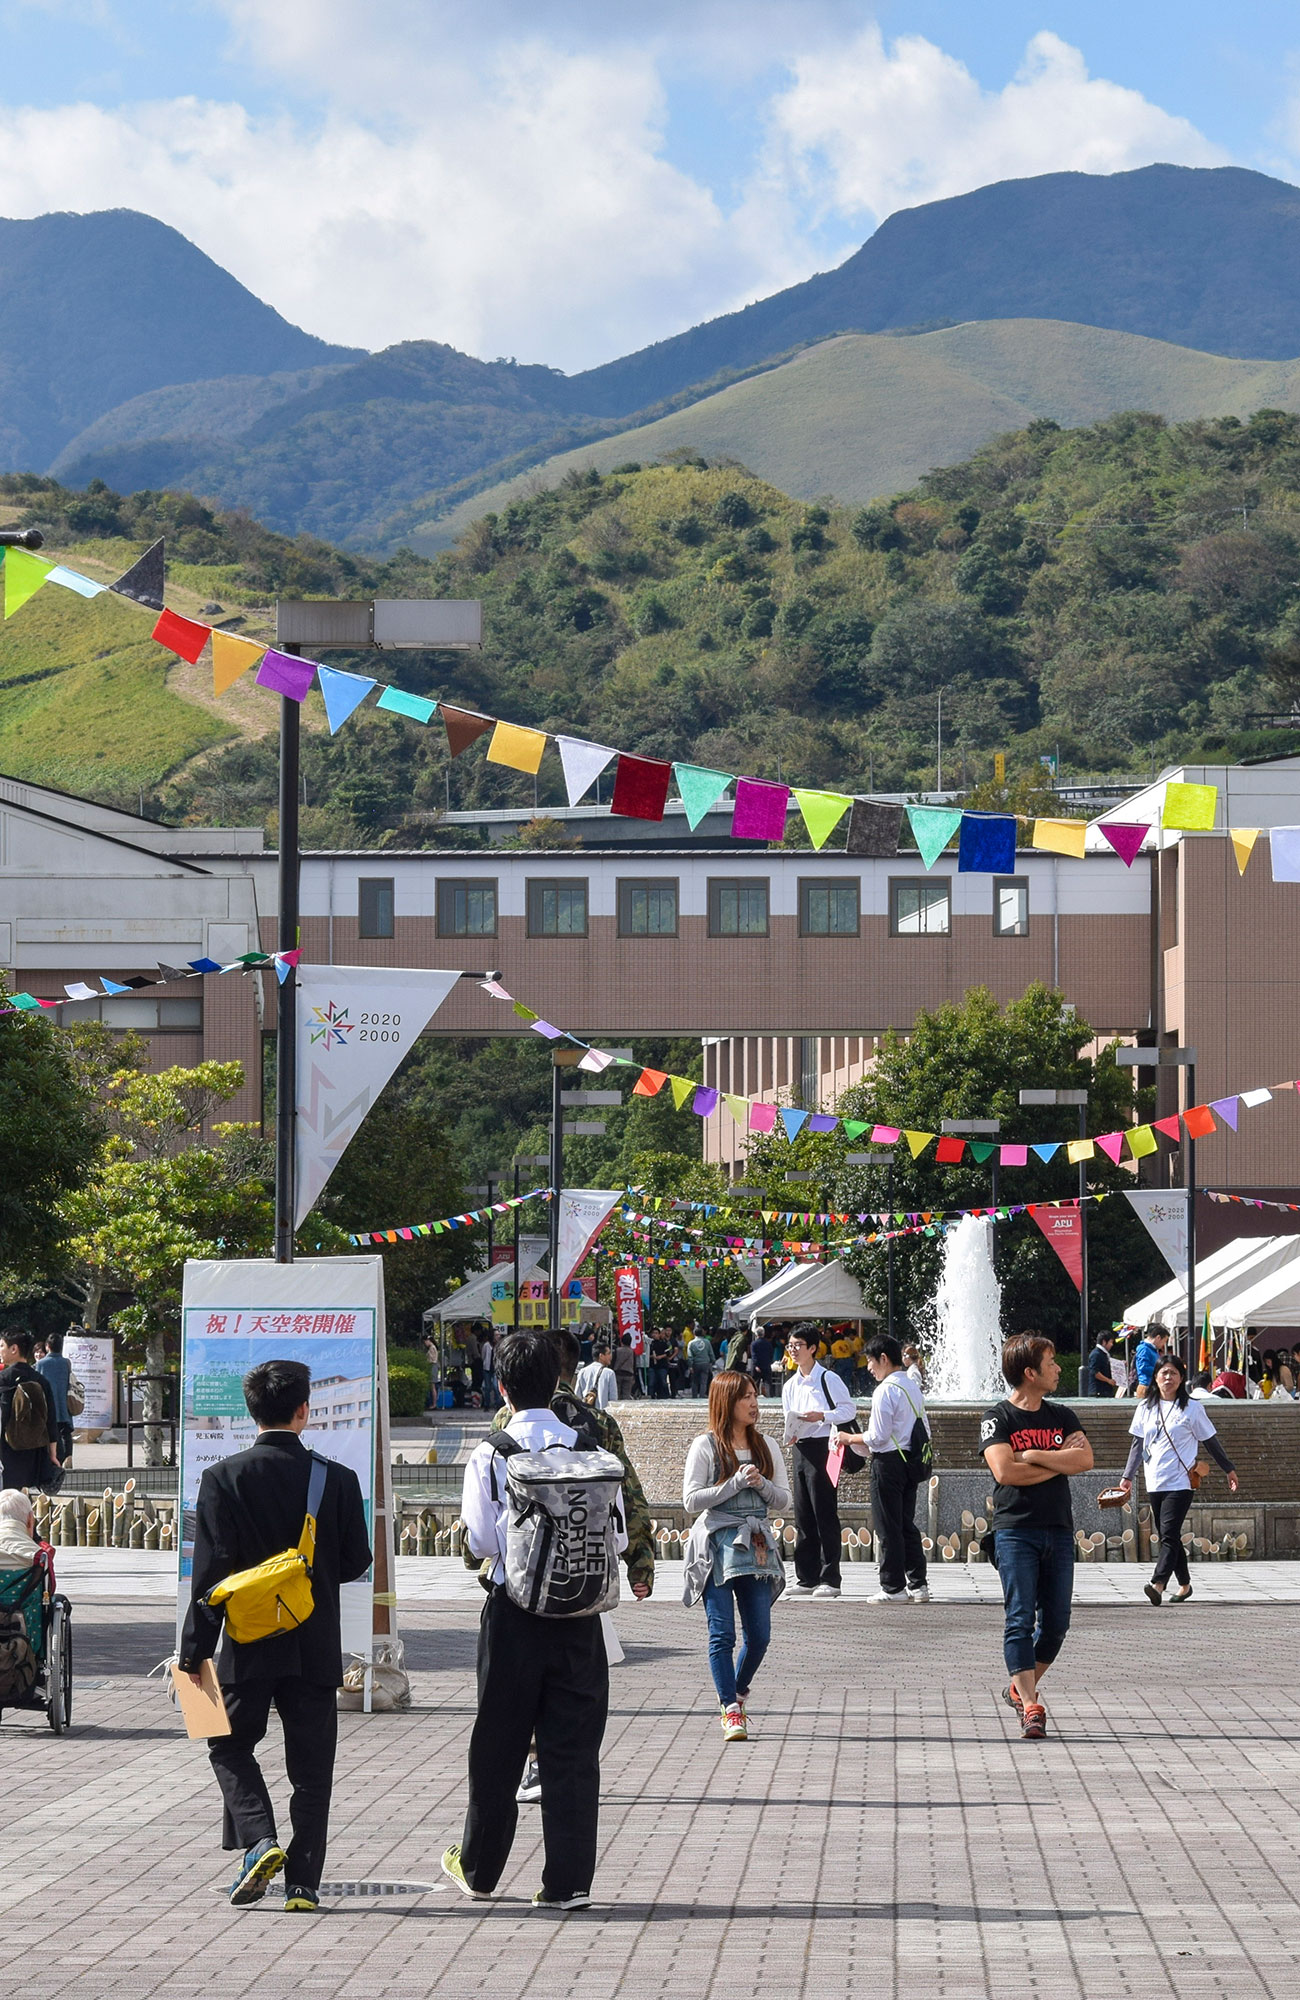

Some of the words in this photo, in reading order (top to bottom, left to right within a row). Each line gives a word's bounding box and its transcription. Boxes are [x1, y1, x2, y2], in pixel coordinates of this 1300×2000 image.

[360, 1013, 401, 1026] 2020
[359, 1030, 400, 1043] 2000
[1051, 1219, 1073, 1229] APU
[617, 1274, 642, 1349] 営業中
[205, 1313, 357, 1334] 祝！天空祭開催
[67, 1352, 108, 1361] ビンゴゲーム
[195, 1432, 224, 1440] 児玉病院
[567, 1489, 588, 1575] NORTH
[552, 1515, 570, 1574] FACE
[587, 1526, 607, 1574] THE
